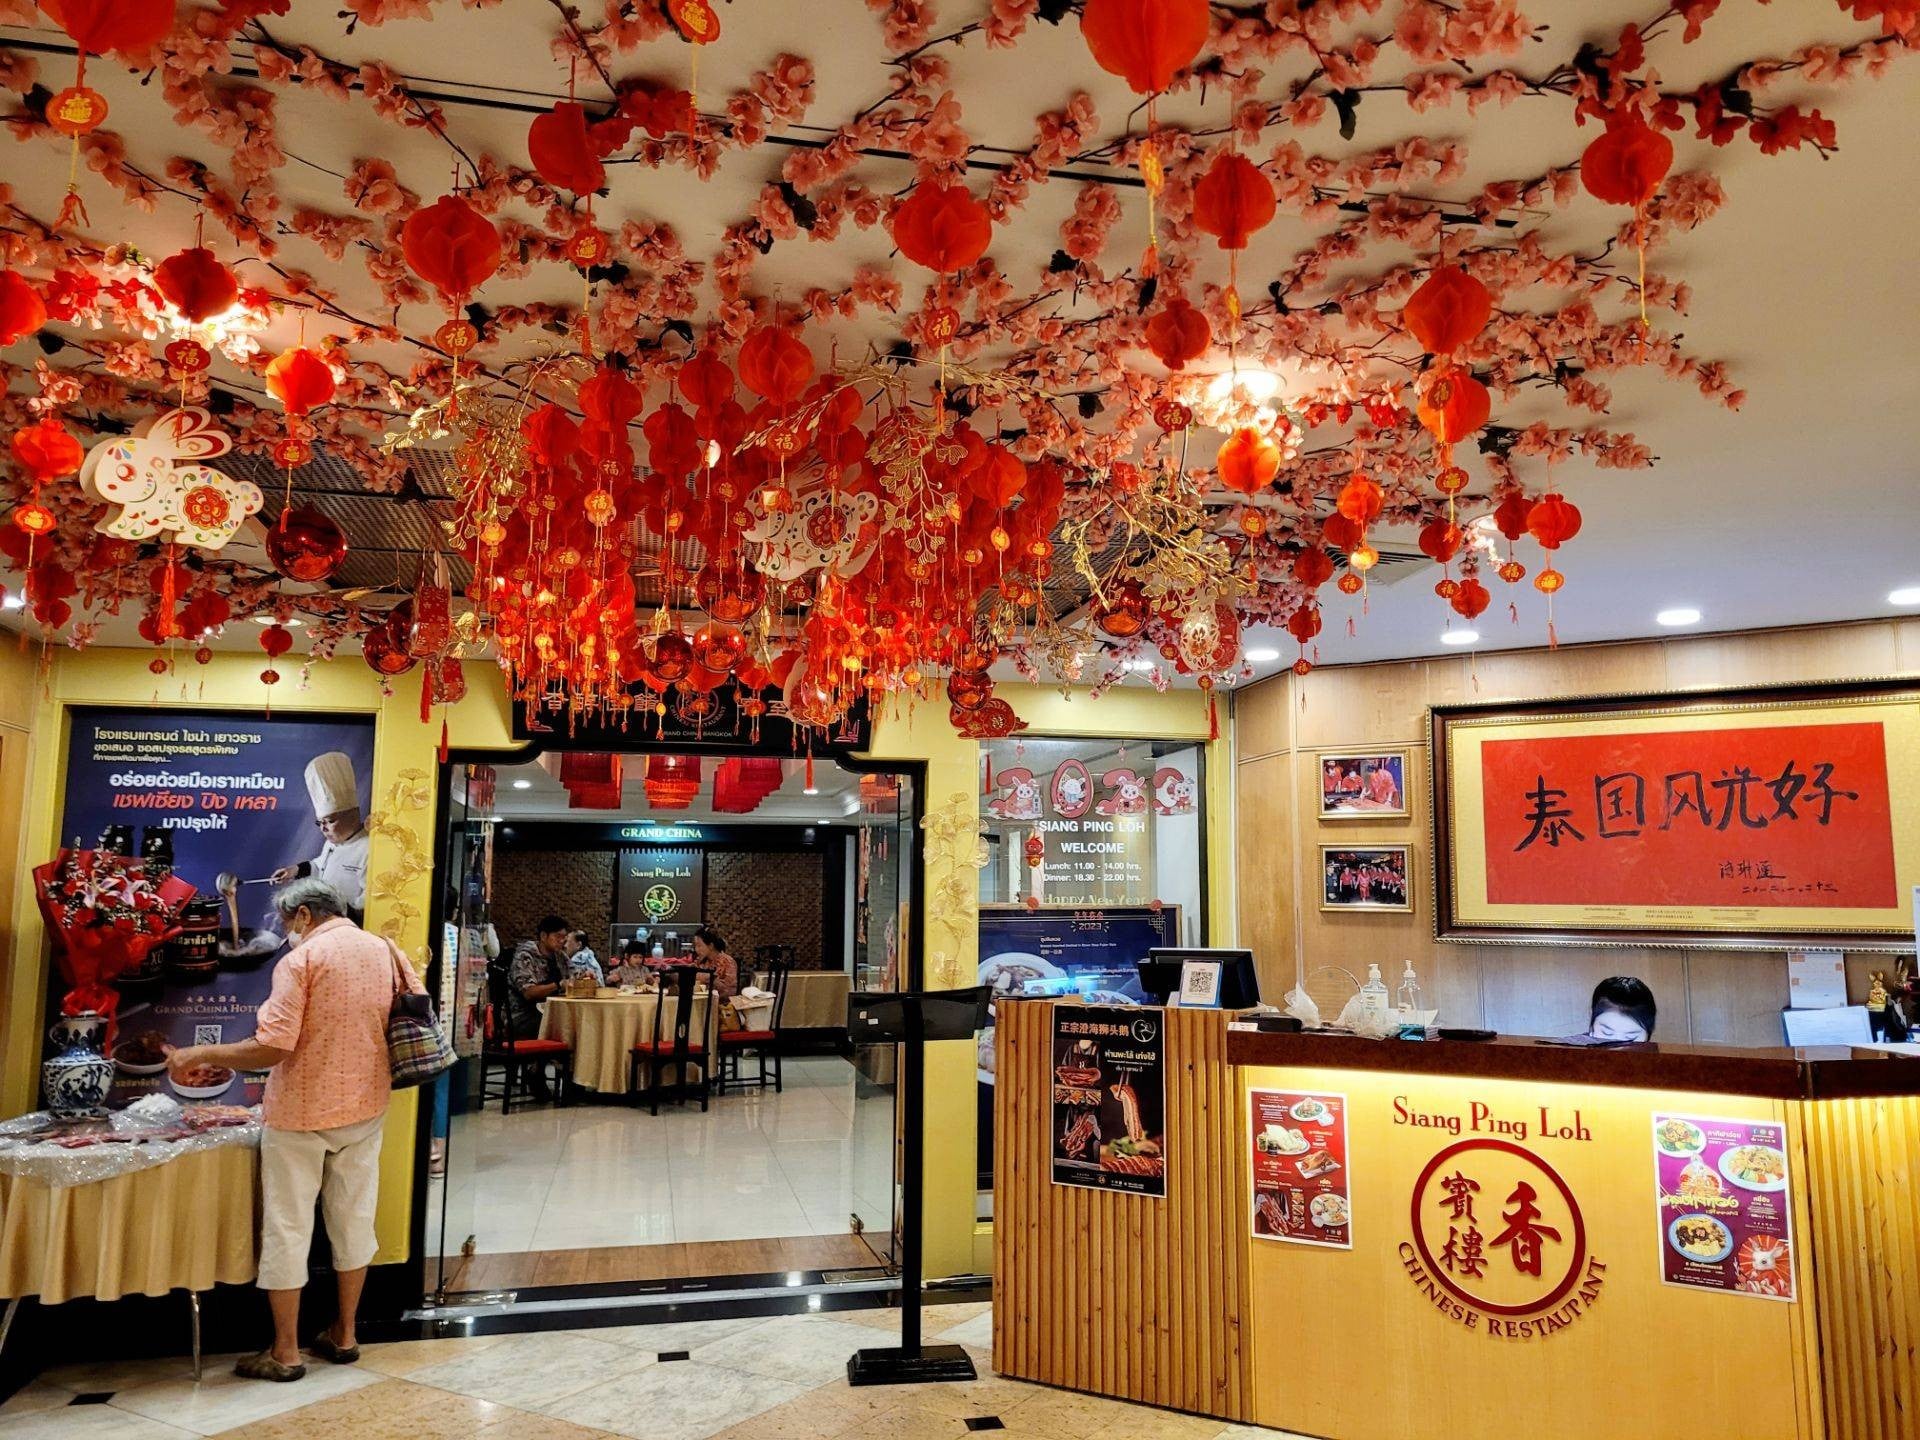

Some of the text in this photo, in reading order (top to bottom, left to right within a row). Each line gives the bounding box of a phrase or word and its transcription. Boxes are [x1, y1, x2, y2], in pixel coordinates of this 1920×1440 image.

[934, 316, 951, 337] 福
[445, 327, 468, 348] 福
[177, 349, 200, 366] 福
[1163, 409, 1182, 426] 福
[776, 433, 793, 451] 福
[603, 459, 619, 476] 福
[592, 494, 608, 510] 福
[559, 550, 575, 566] 福
[793, 585, 806, 599] 福
[214, 733, 261, 744] เยาวราช
[109, 770, 285, 790] อร่อยด้วยมือเราเหมือน
[234, 794, 279, 810] เหลา
[1514, 760, 1859, 852] 泰国风光好
[162, 813, 229, 833] มาปรุงให้
[1039, 820, 1145, 833] SIANG PING LOH
[621, 827, 702, 839] GRAND CHINA
[1061, 842, 1125, 853] WELCOME
[630, 866, 691, 878] Siang Ping Loh
[1044, 862, 1071, 870] Lunch:
[1074, 862, 1095, 870] 11.00
[1104, 862, 1125, 870] 14.00
[1043, 874, 1071, 882] Dinner:
[1074, 874, 1095, 882] 18.30
[1079, 922, 1102, 931] 2023
[155, 1003, 259, 1014] GRAND CHINA HOT
[1393, 1095, 1592, 1141] Siang Ping Loh
[1489, 1181, 1562, 1277] 香
[1398, 1241, 1479, 1328] CHINESE
